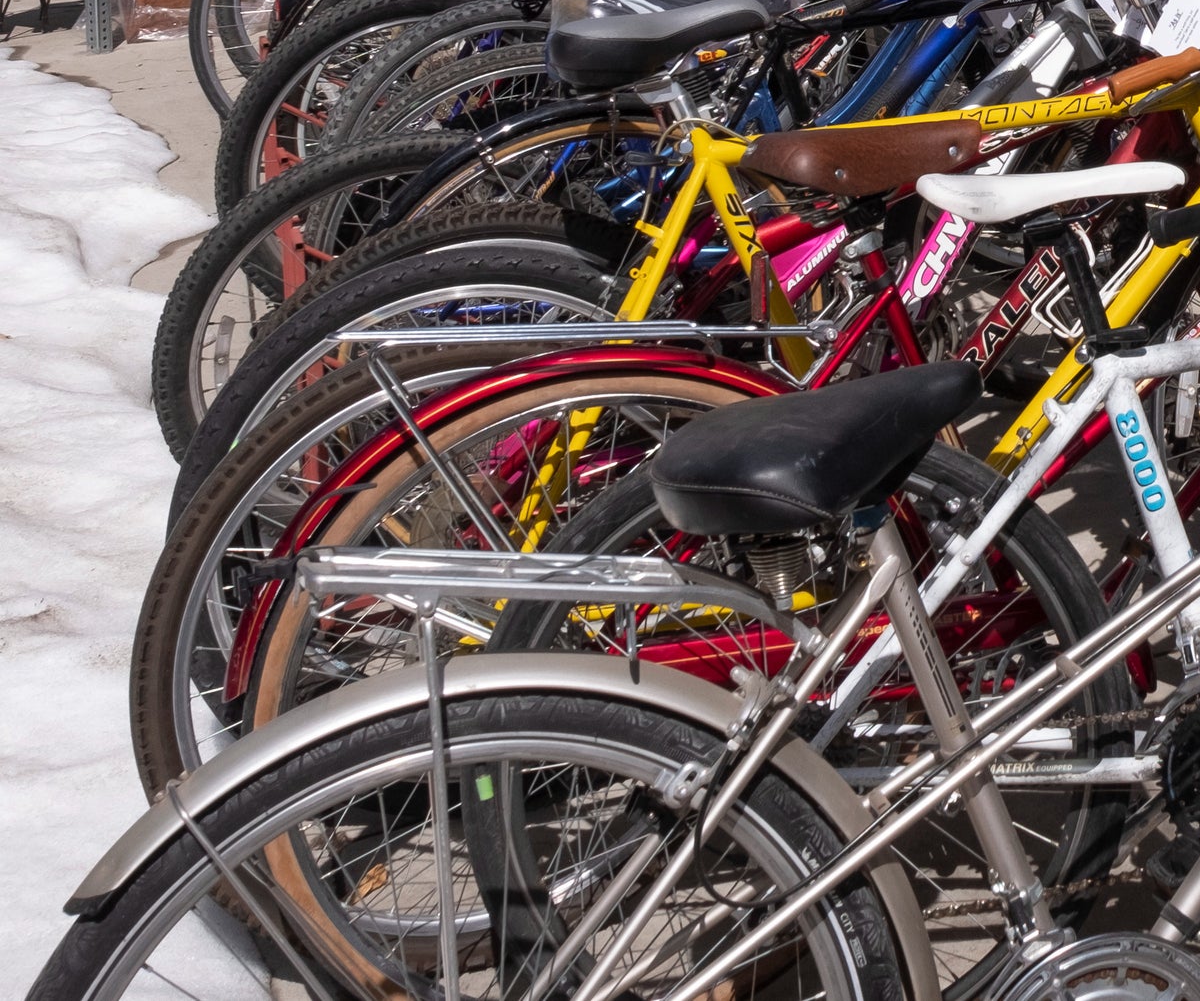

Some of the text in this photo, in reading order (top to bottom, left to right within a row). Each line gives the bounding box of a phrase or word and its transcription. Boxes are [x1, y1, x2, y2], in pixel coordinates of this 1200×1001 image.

[960, 95, 1133, 125] MONTAG
[787, 227, 850, 292] ALUMINU
[961, 246, 1062, 368] RALEI
[1035, 764, 1073, 773] EQUIPPED
